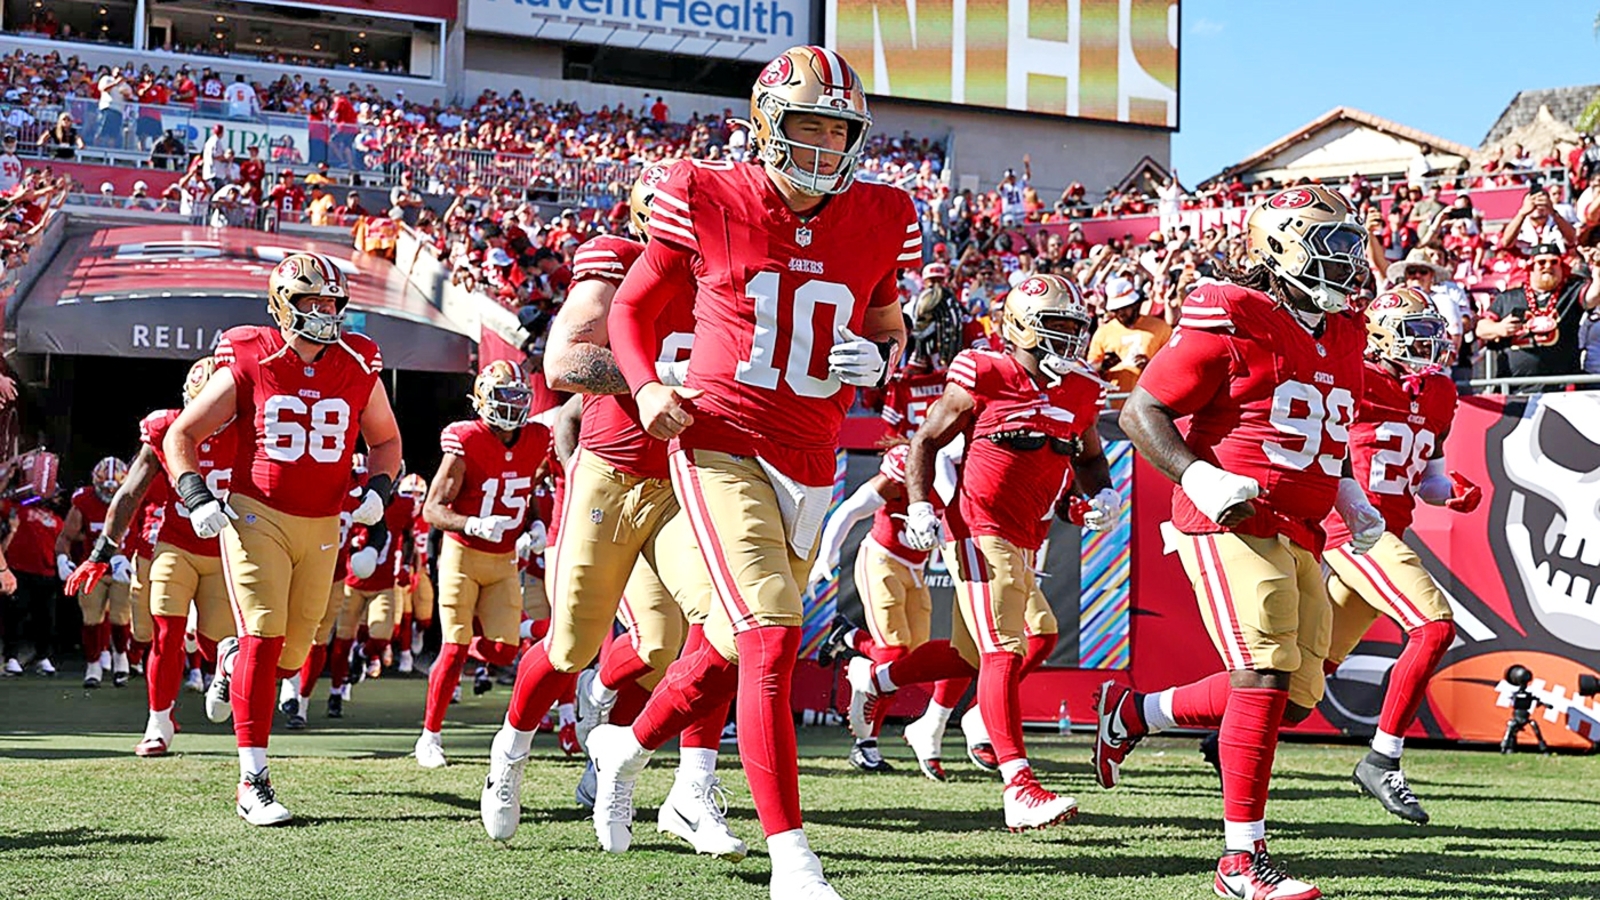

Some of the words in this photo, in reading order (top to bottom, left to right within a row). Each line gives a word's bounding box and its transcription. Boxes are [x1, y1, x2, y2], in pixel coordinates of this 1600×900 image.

[486, 0, 794, 37] ventHealth
[282, 196, 293, 212] 6
[788, 257, 824, 275] 49ERS
[734, 271, 855, 399] 10
[264, 394, 350, 463] 68
[1262, 379, 1355, 478] 99
[480, 477, 532, 531] 15
